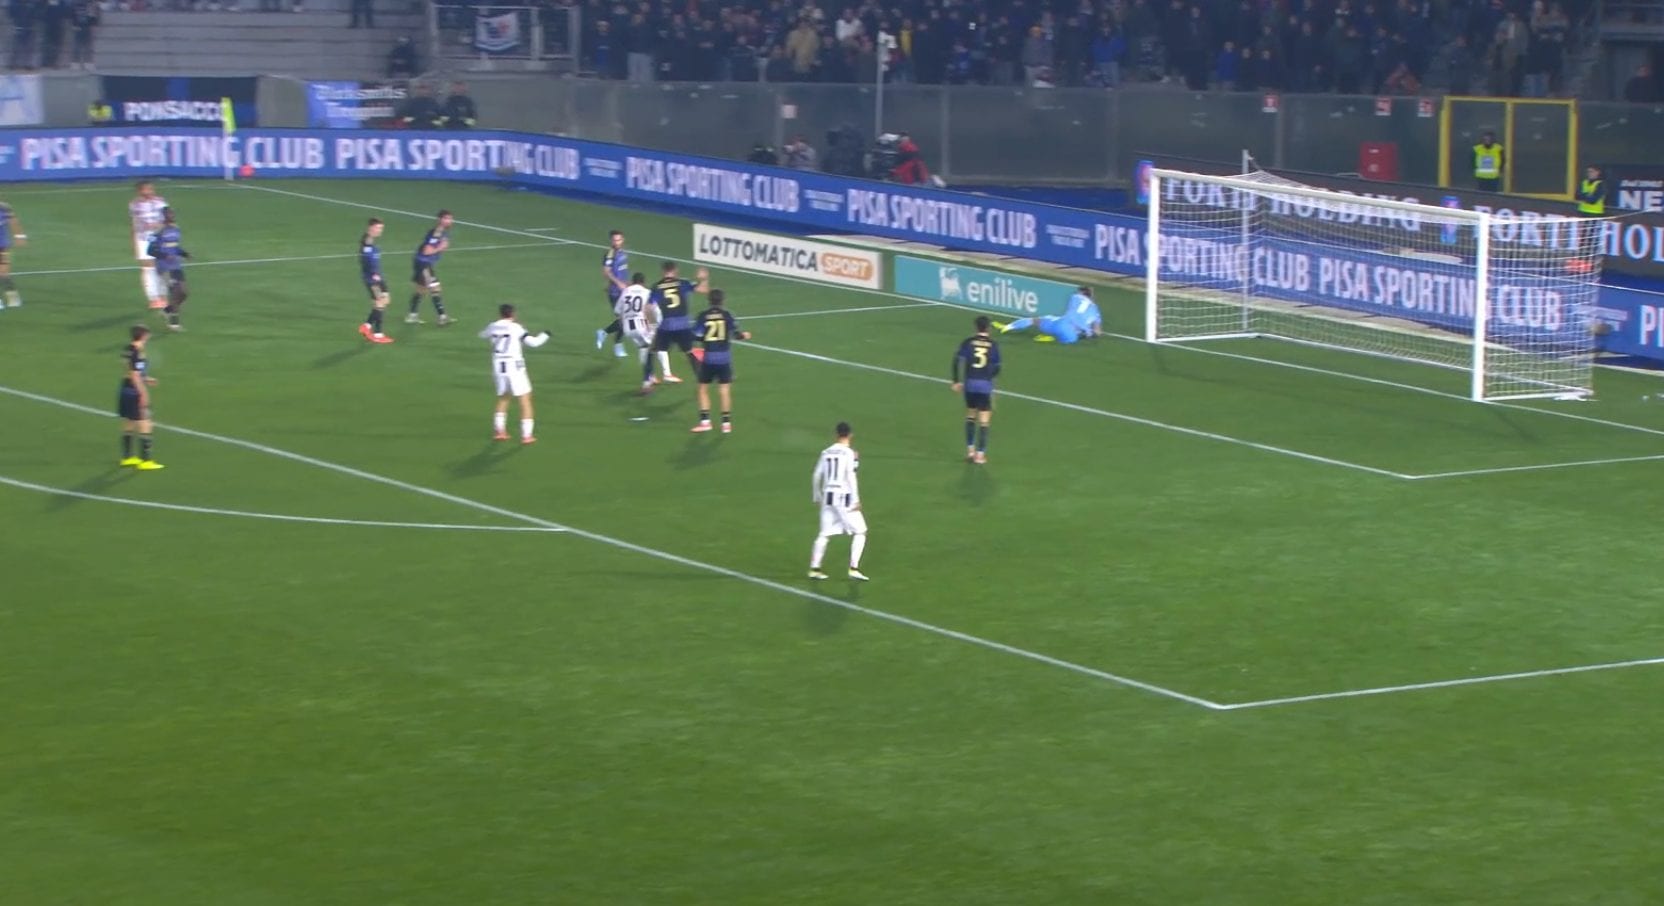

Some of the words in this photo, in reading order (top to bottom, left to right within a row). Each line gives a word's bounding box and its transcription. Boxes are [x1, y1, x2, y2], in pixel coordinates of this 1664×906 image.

[123, 101, 224, 121] PONSACC
[21, 137, 89, 170] PISA
[92, 135, 239, 168] SPORTING
[245, 136, 325, 169] CLUB
[335, 138, 404, 170] PISA
[408, 139, 534, 174] SPORTING
[535, 144, 580, 180] CLUB
[626, 156, 666, 194] PISA
[666, 162, 751, 206] SPORTING
[753, 174, 799, 212] CLUB
[847, 188, 888, 227] PISA
[891, 196, 984, 242] SPORTING
[986, 207, 1037, 249] CLUB
[700, 233, 818, 272] LOTTOMATICA
[823, 255, 869, 280] SPORT
[1095, 223, 1142, 266] PISA
[1254, 247, 1310, 292] CLUB
[624, 295, 643, 313] 30
[664, 287, 680, 309] 5
[967, 277, 1038, 313] enilive
[1319, 257, 1369, 302] PISA
[1373, 265, 1492, 322] SPORTIN
[1498, 284, 1562, 331] CLUB
[703, 319, 726, 342] 21
[971, 346, 988, 369] 3
[825, 457, 839, 481] 11
